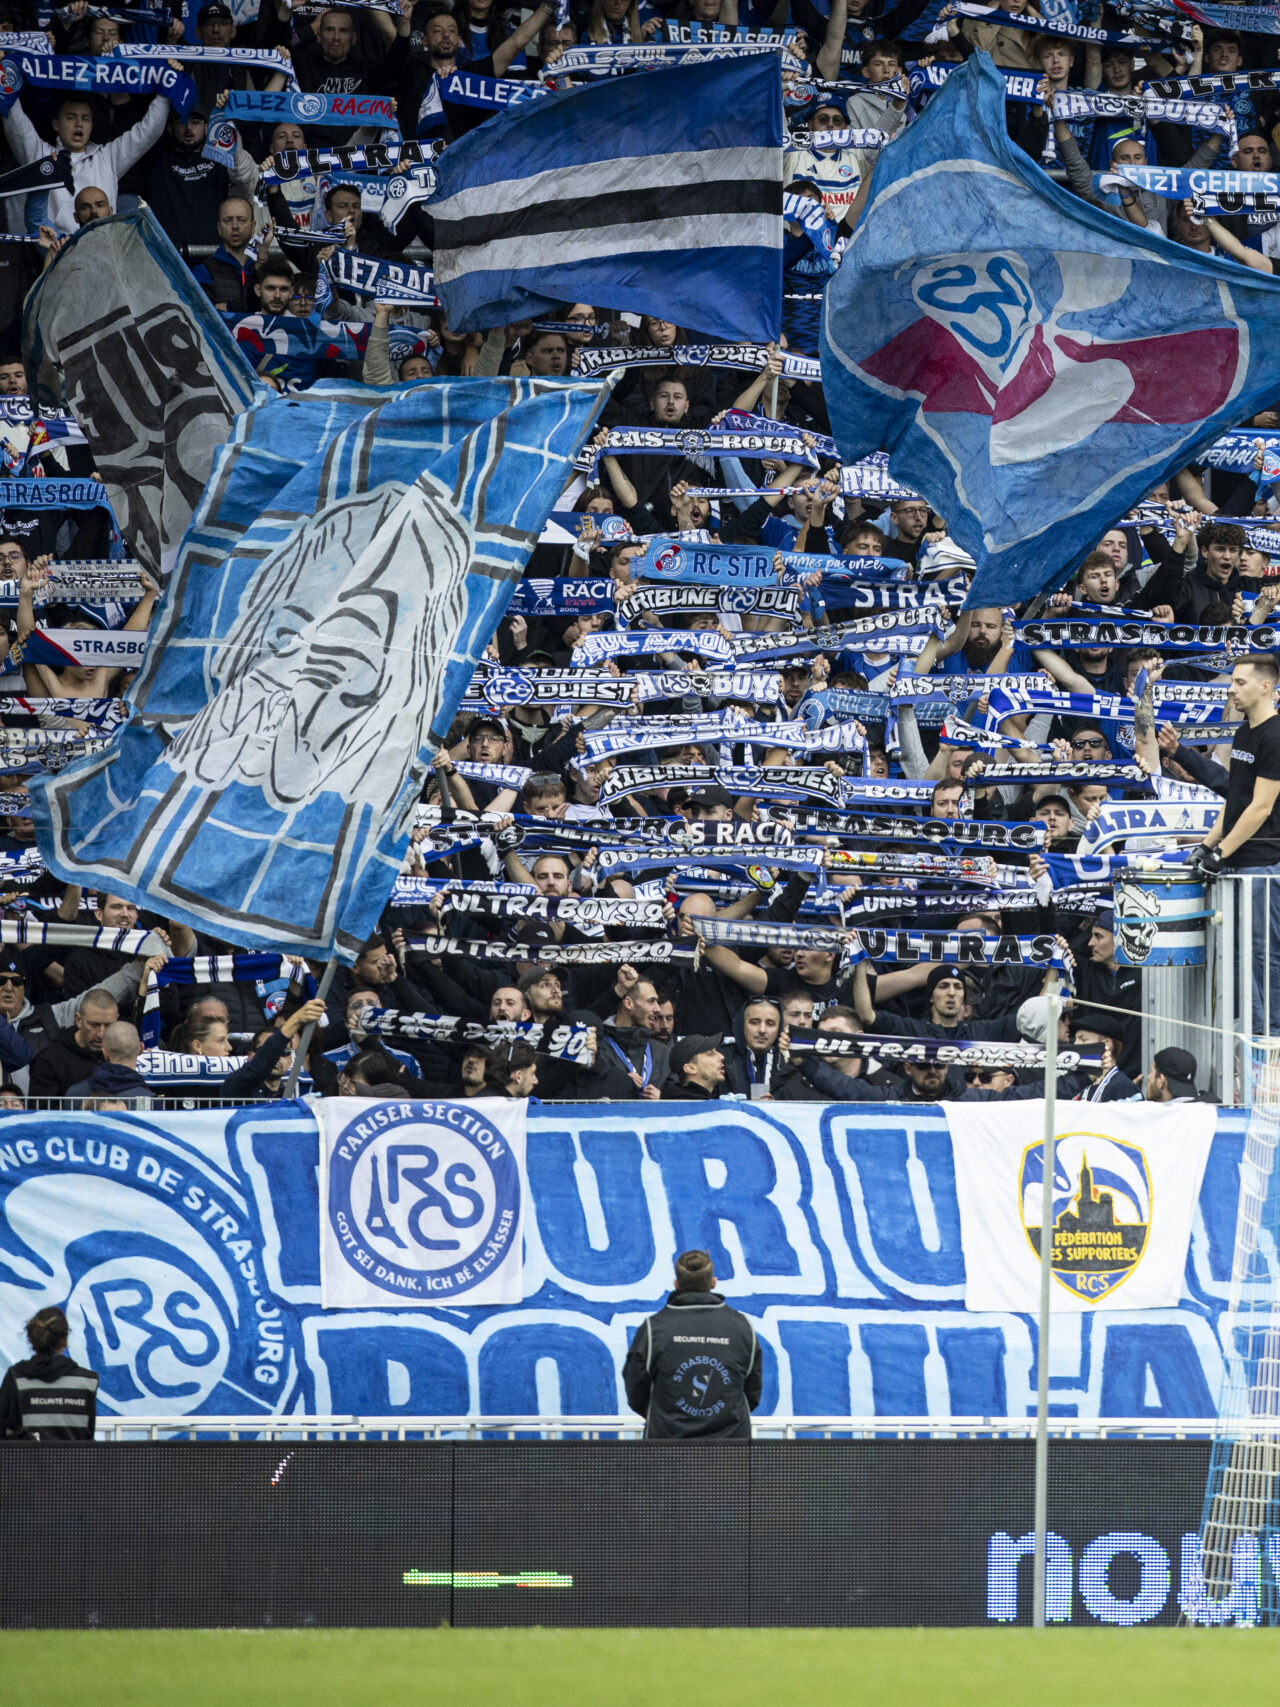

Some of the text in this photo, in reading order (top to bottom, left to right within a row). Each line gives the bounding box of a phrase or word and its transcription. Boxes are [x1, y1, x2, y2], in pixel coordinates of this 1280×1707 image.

[22, 57, 180, 89] ALLEZ RACING
[447, 75, 526, 108] ALLEZ
[1123, 166, 1179, 194] ETZT
[692, 552, 720, 575] RC
[1023, 622, 1278, 654] STRASBOURG
[535, 681, 633, 701] OUEST
[768, 805, 1047, 849] STRASBOURG
[862, 895, 918, 914] UNIS
[857, 929, 1057, 965] ULTRAS
[338, 1102, 506, 1161] PARISER SECTION
[45, 1136, 130, 1172] CLUB
[136, 1156, 184, 1194] DE
[336, 1211, 358, 1249] GOTT
[352, 1248, 376, 1270] SEI
[374, 1265, 422, 1292] DANK,
[473, 1209, 514, 1274] ELSÄSSER
[1053, 1229, 1123, 1247] FÉDÉRATION
[1064, 1246, 1140, 1262] SUPPORTERS
[1075, 1274, 1111, 1293] RCS
